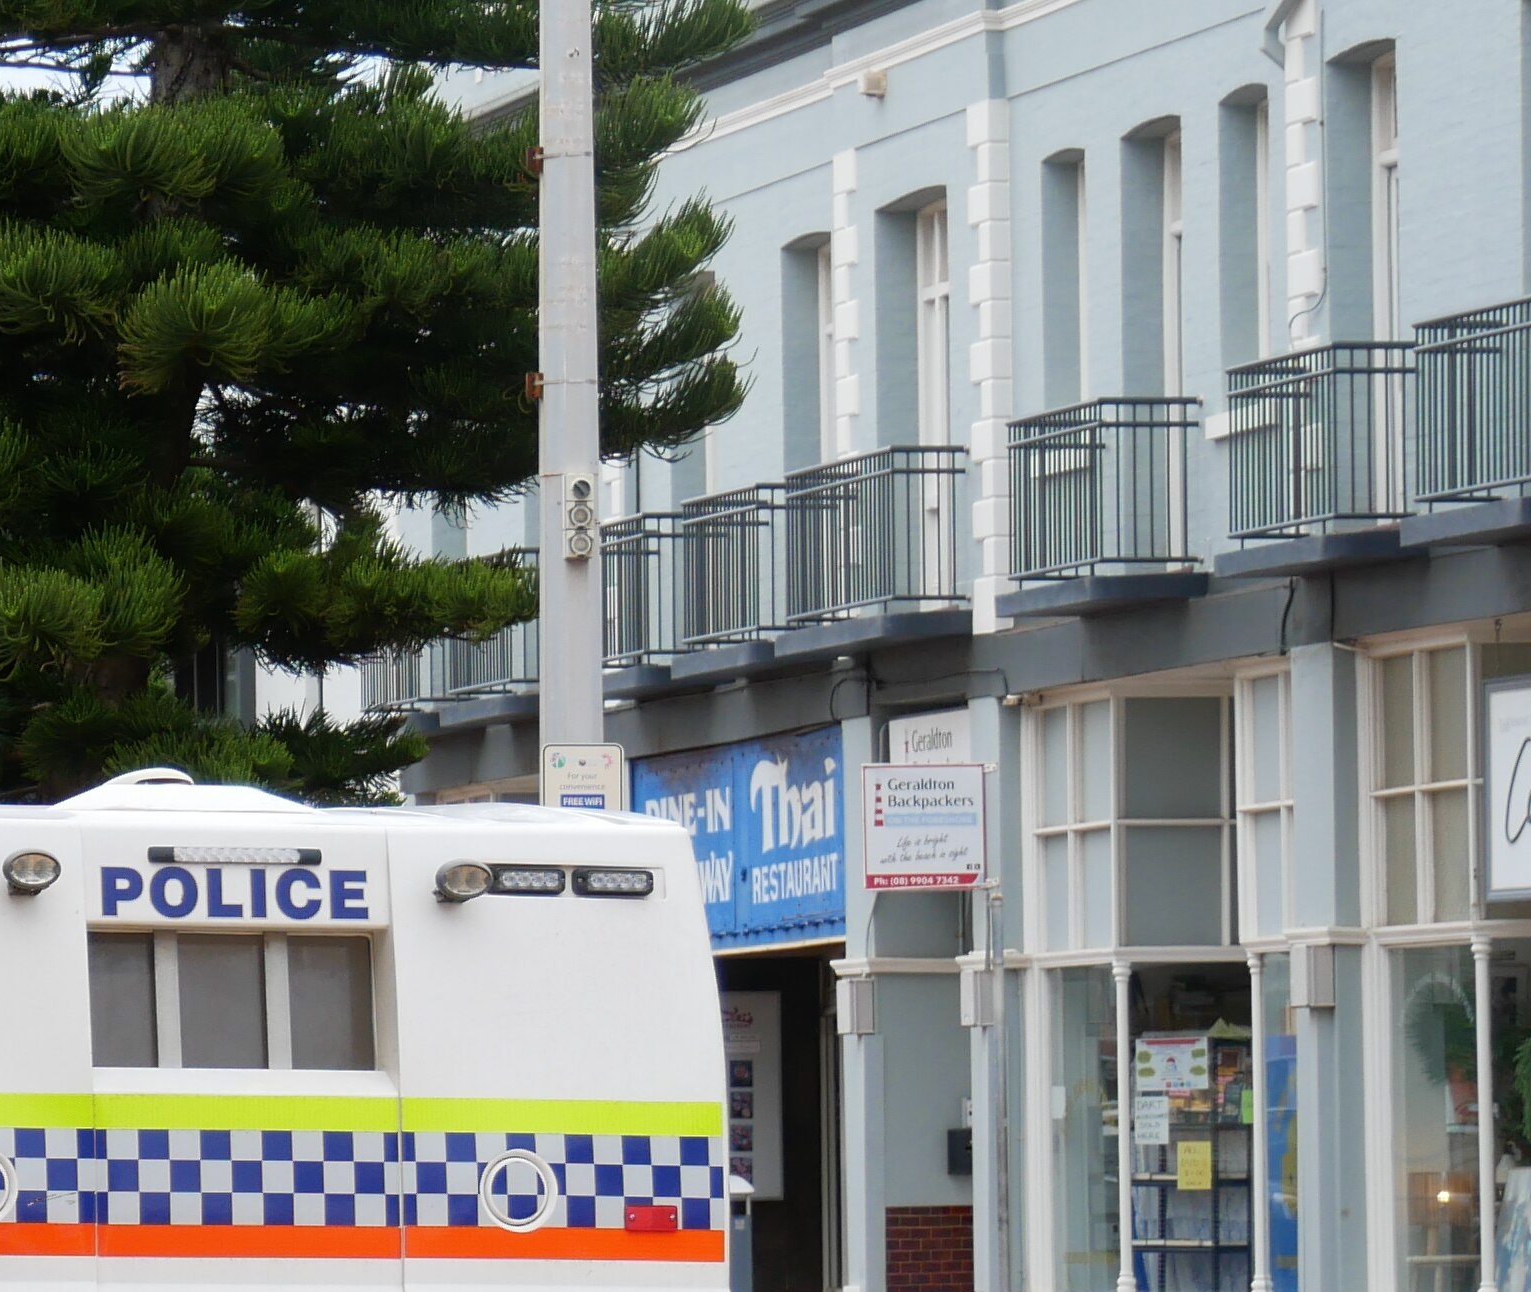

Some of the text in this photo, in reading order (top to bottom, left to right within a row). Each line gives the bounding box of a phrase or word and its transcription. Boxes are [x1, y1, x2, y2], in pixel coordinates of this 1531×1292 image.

[911, 726, 953, 753] Geraldton
[887, 777, 955, 791] Geraldton
[563, 796, 584, 806] FREE
[750, 754, 836, 854] Thai
[887, 794, 974, 810] Backpackers
[752, 853, 838, 904] RESTAURANT
[873, 877, 888, 886] Ph:
[890, 877, 908, 887] (08)
[909, 876, 933, 886] 9904
[101, 866, 369, 920] POLICE
